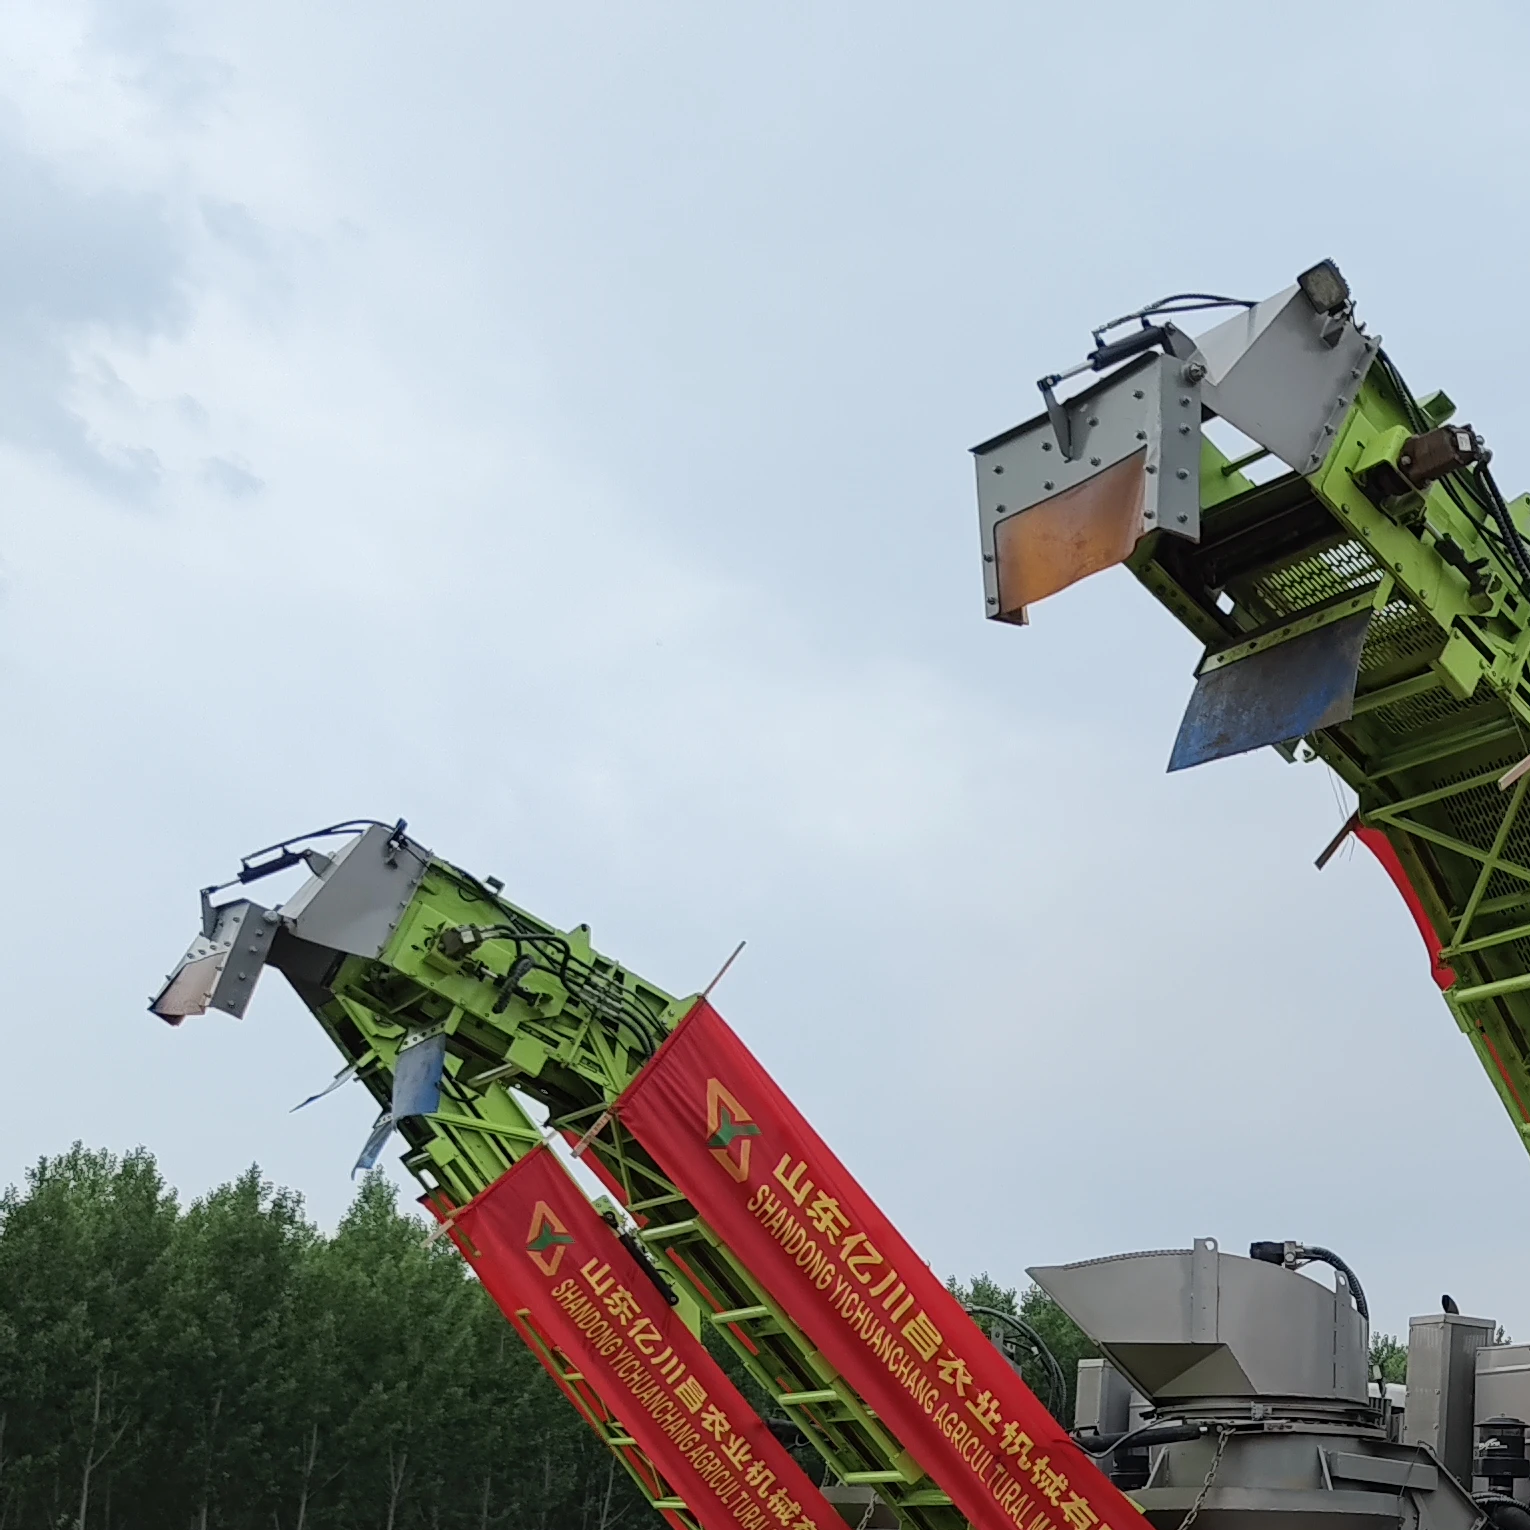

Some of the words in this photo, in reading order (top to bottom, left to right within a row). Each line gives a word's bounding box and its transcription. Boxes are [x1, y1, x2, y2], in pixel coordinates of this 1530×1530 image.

[551, 1278, 623, 1356] SHANDONG
[609, 1346, 700, 1452] YICHUANCHANG
[747, 1185, 836, 1290] SHANDONG
[828, 1274, 939, 1414] YICHUANCHANG
[933, 1402, 1036, 1530] AGRICULTURAL
